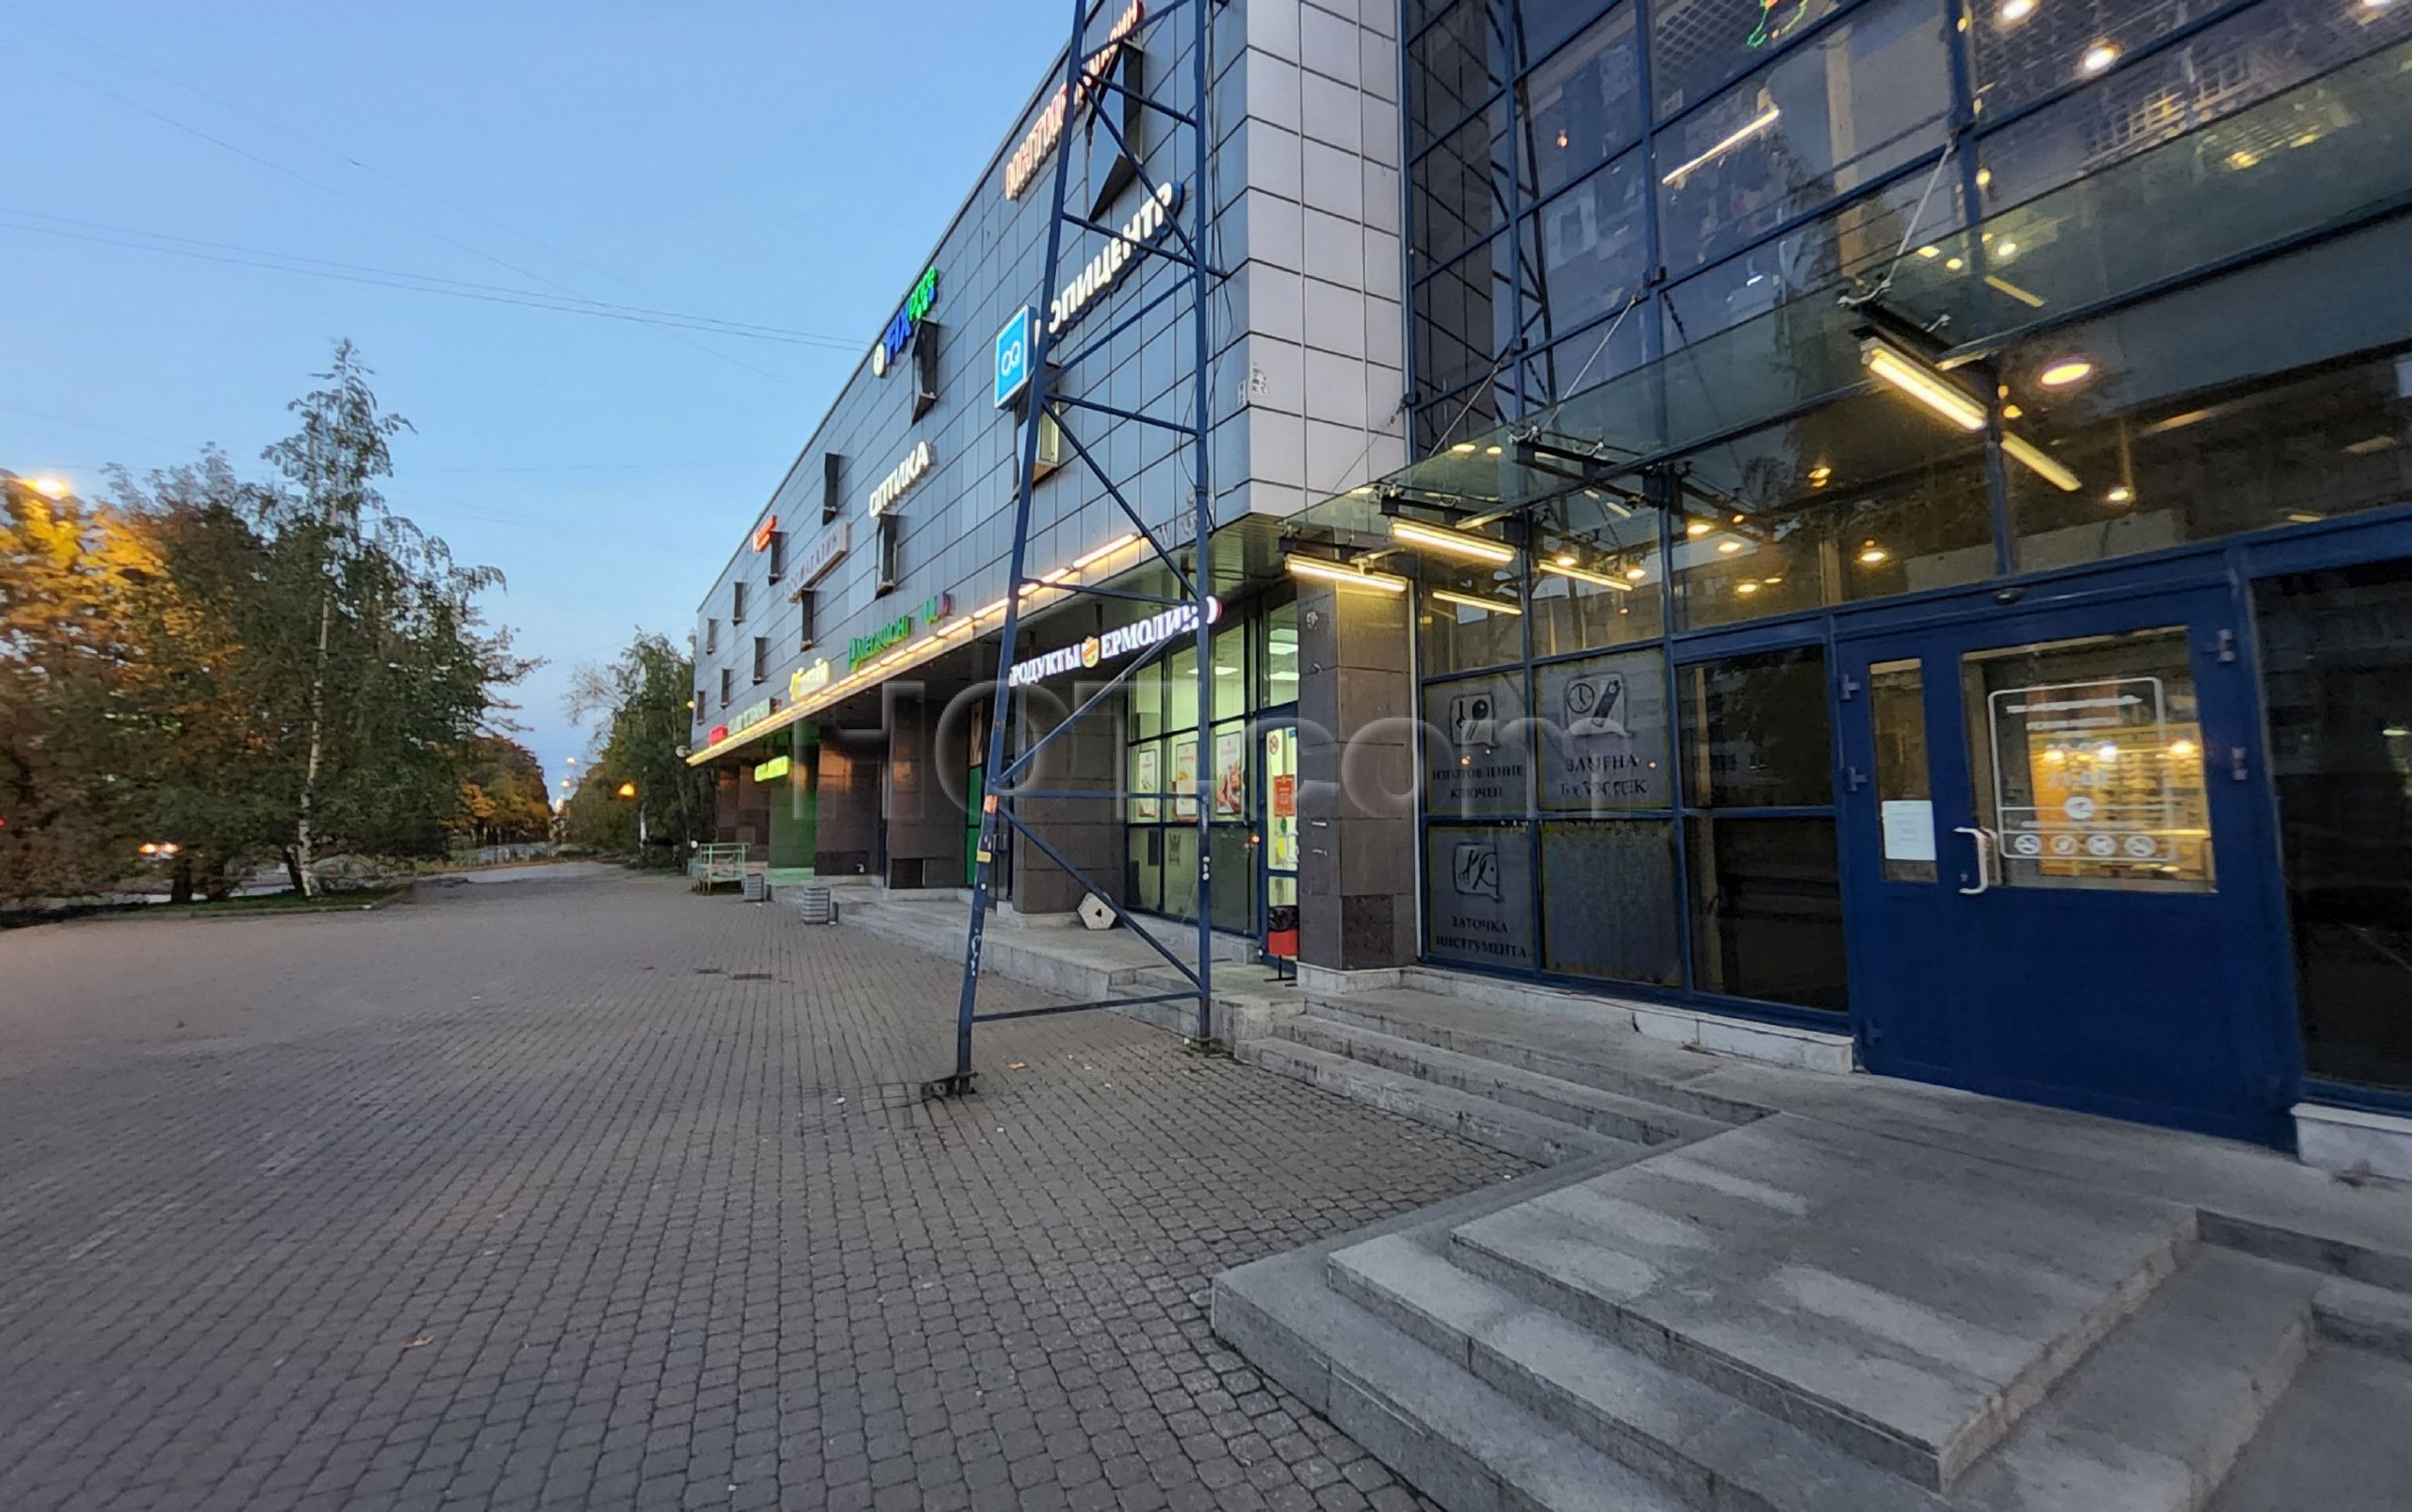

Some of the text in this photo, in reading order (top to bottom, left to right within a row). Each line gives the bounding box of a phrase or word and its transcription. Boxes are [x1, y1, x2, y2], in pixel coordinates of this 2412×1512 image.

[869, 441, 931, 517] ОПТИКА
[1007, 643, 1082, 688] РОДУКТЫ
[1565, 755, 1638, 772] ЗАМЕНА
[1451, 915, 1508, 933] ЗАТОЧКА
